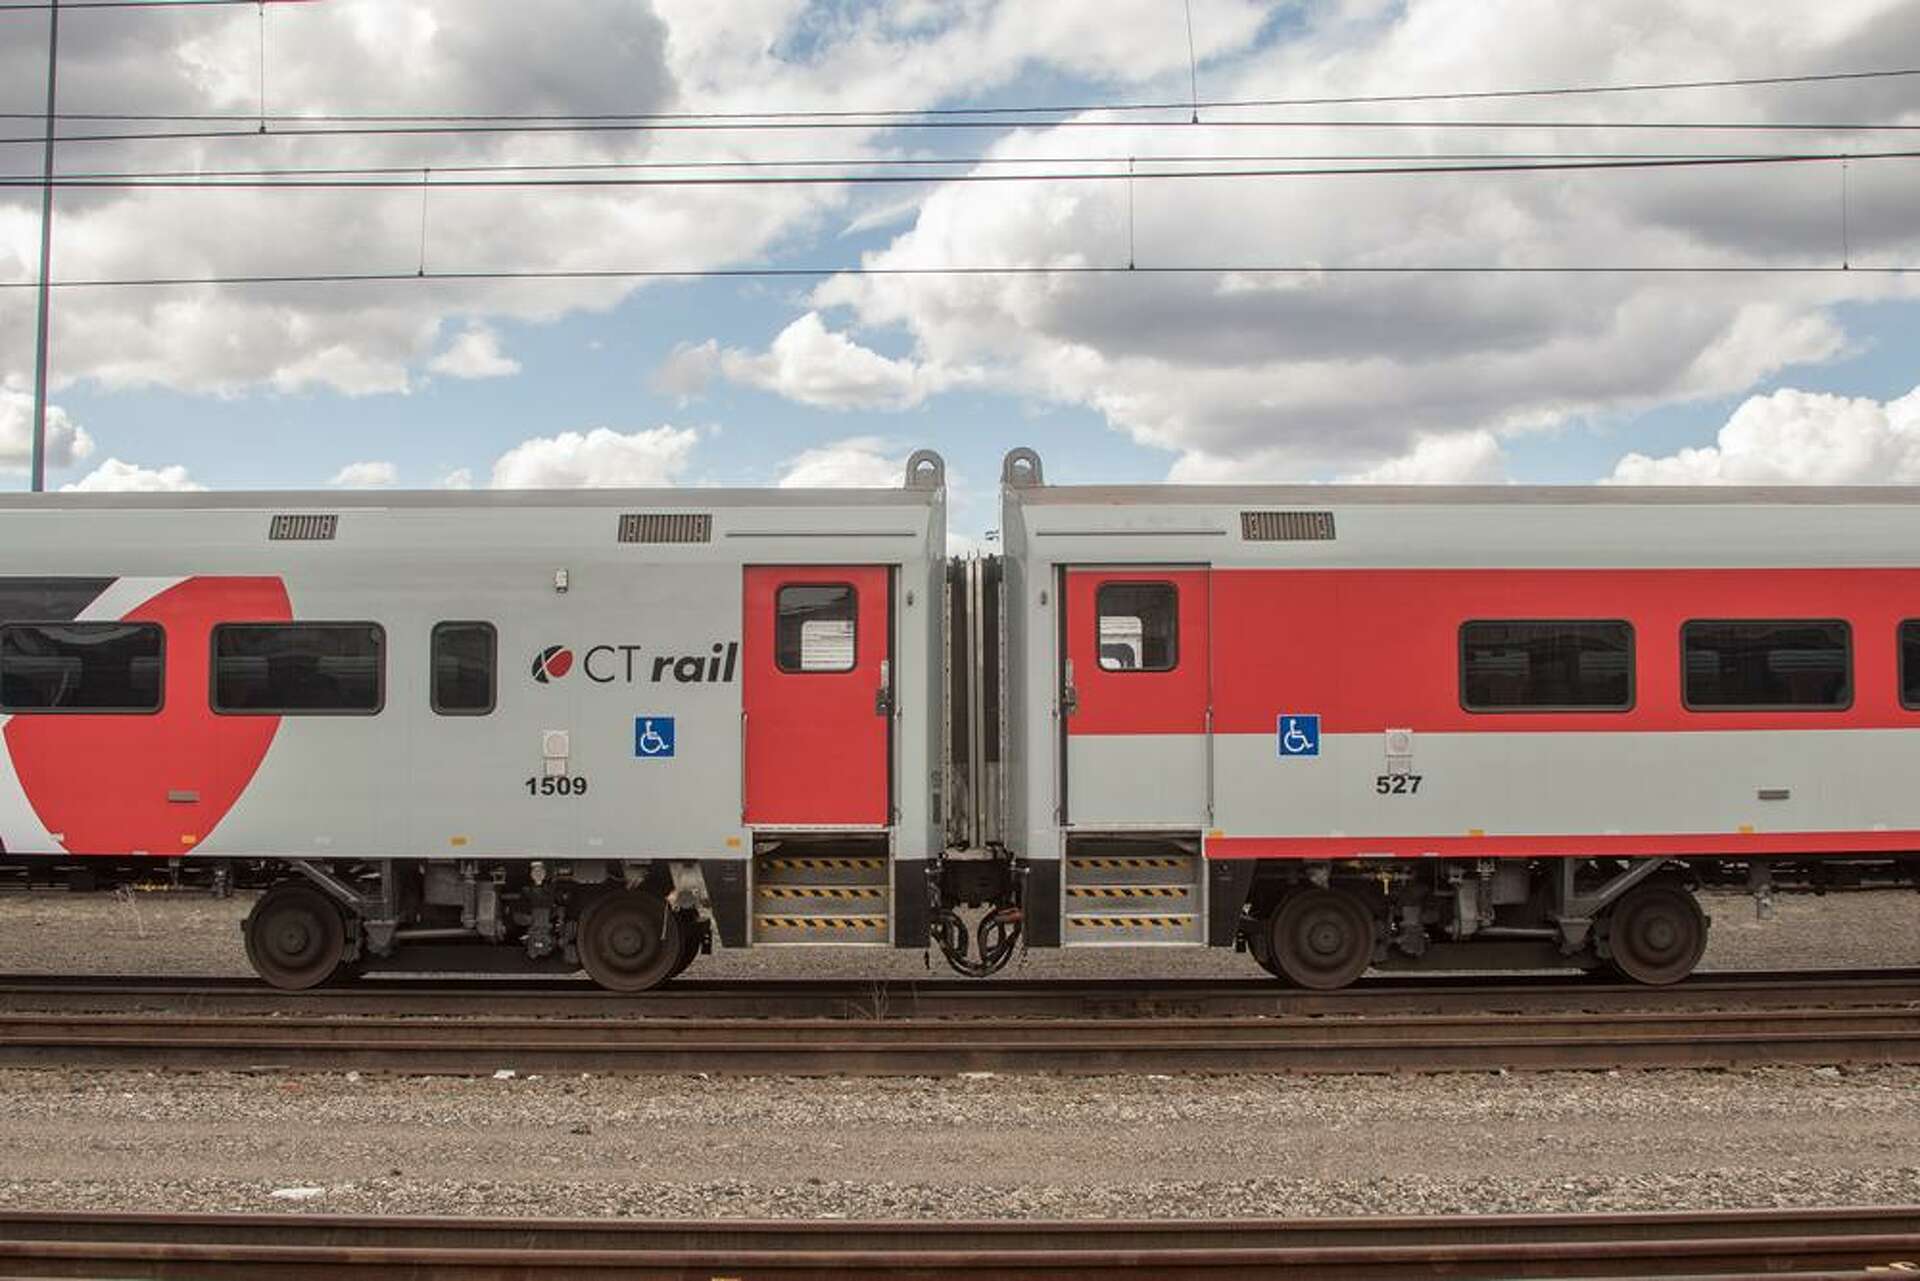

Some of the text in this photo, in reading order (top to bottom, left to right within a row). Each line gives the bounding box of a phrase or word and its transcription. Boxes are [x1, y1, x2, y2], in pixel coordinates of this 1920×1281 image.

[583, 642, 738, 683] CT rail
[525, 776, 587, 796] 1509
[1376, 775, 1422, 794] 527
